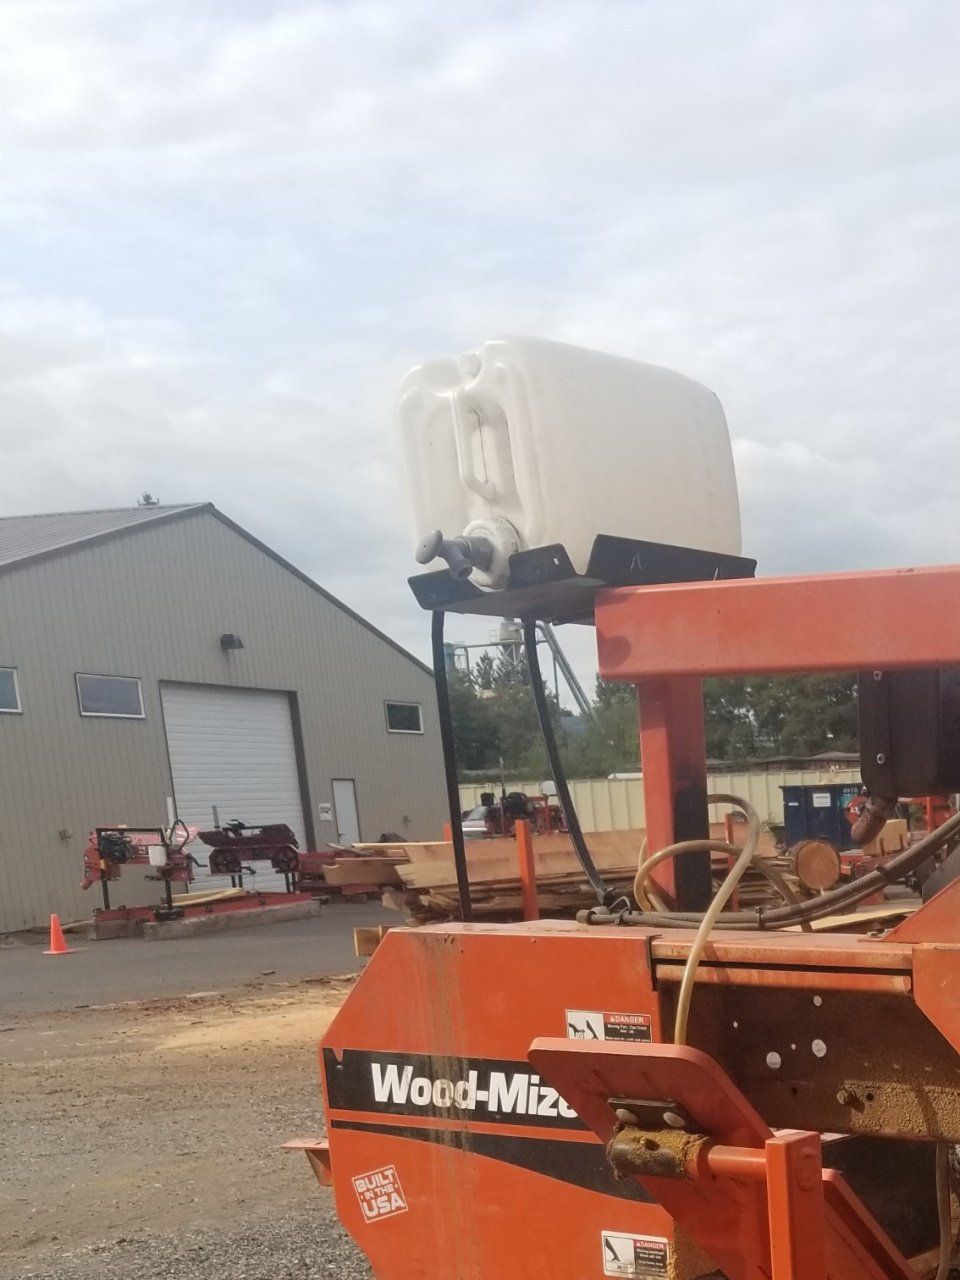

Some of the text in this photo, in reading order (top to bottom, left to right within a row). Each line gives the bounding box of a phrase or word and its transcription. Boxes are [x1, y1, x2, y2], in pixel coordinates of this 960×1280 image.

[614, 1016, 644, 1024] DANGER
[355, 1168, 394, 1192] BUILT
[364, 1184, 394, 1200] IN THE
[362, 1192, 406, 1218] USA
